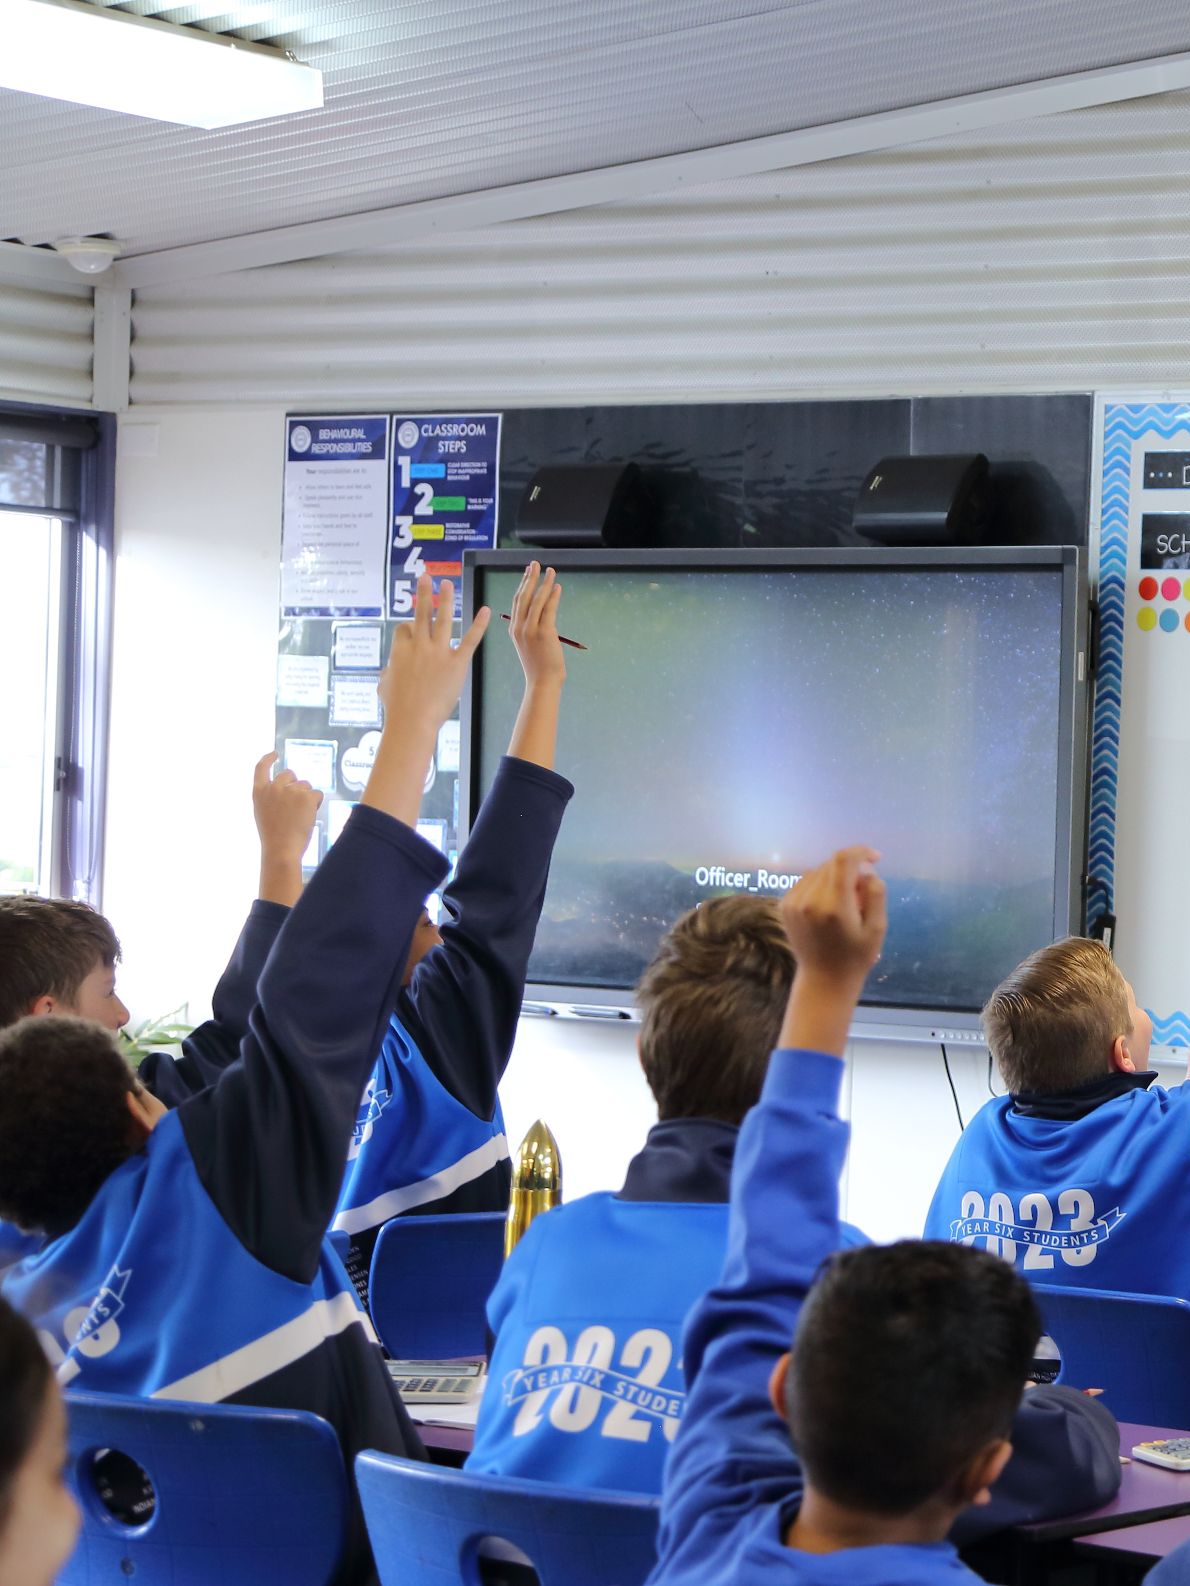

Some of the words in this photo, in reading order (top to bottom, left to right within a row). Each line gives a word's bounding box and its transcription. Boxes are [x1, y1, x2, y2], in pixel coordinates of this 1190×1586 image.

[318, 427, 367, 440] BEHAVIOURAL
[420, 423, 487, 436] CLASSROOM
[311, 441, 373, 454] RESPONSIBILITIES
[438, 440, 467, 453] STEPS
[397, 455, 411, 488] 1
[413, 482, 434, 516] 2
[393, 515, 414, 549] 3
[403, 546, 426, 578] 4
[393, 580, 414, 613] 5
[961, 1220, 990, 1236] YEAR
[994, 1222, 1015, 1239] SIX
[1022, 1228, 1099, 1248] STUDENTS
[511, 1325, 686, 1443] 202
[523, 1367, 572, 1391] YEAR
[574, 1366, 606, 1388] SIX
